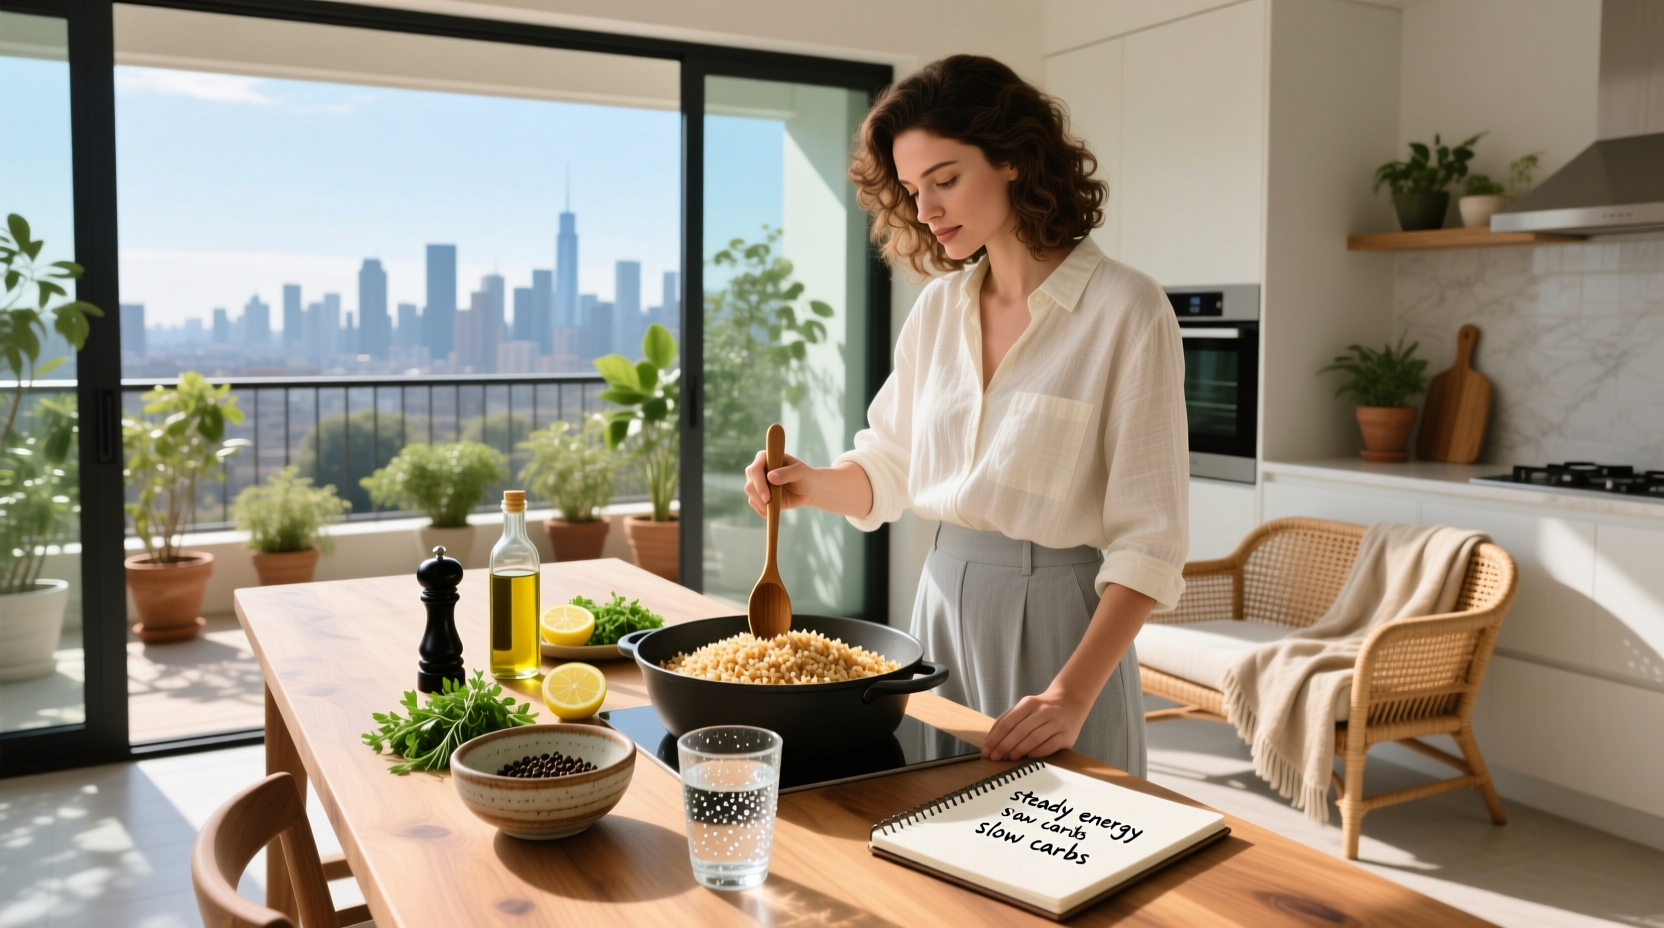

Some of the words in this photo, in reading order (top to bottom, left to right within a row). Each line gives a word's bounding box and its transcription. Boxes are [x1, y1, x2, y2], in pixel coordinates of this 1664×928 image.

[1009, 790, 1074, 821] steady
[1079, 812, 1144, 844] energy
[975, 821, 1025, 844] slow
[1029, 839, 1090, 865] carbs
